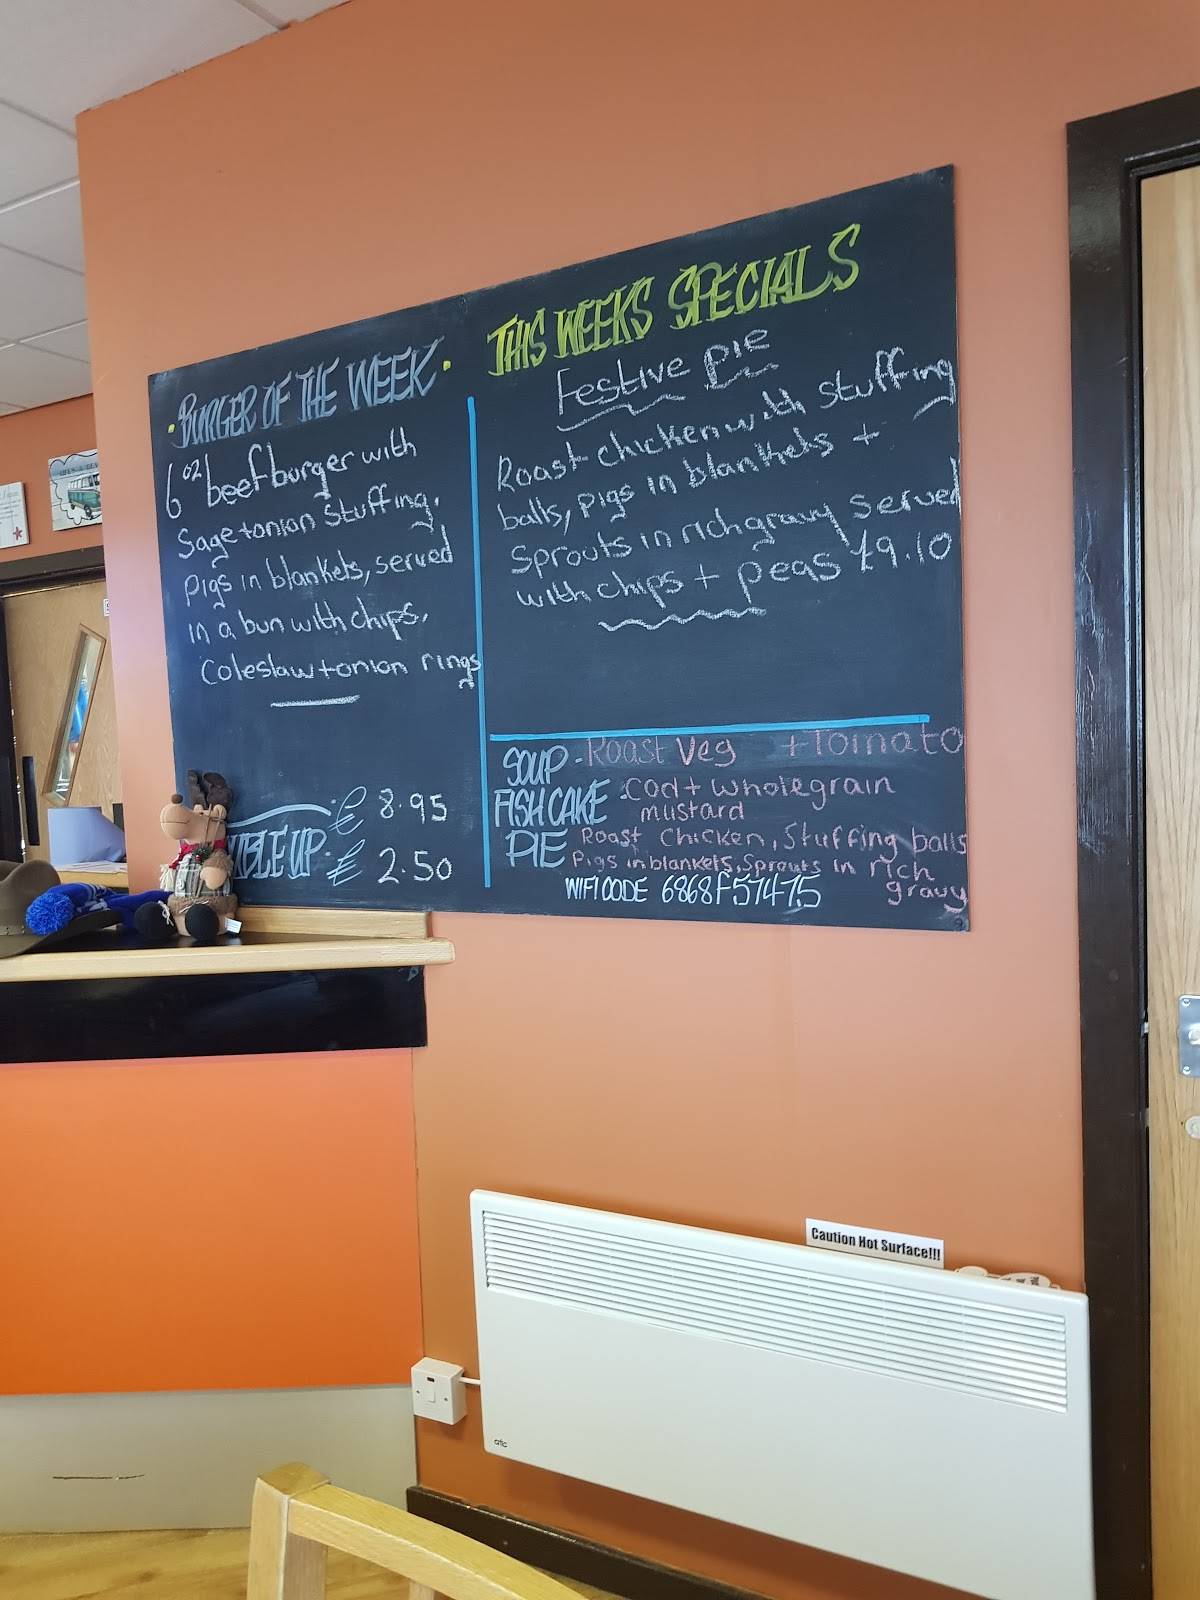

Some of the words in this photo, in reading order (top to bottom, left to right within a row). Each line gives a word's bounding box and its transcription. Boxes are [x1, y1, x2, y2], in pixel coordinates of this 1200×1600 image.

[487, 307, 548, 377] THIS
[553, 275, 655, 359] WEEKS
[668, 223, 861, 330] SPECIALS
[171, 392, 258, 449] BURGER
[260, 371, 293, 430] OF
[295, 356, 340, 422] THE
[346, 335, 445, 412] WEEK
[362, 427, 417, 466] with
[498, 441, 588, 492] Roast
[647, 474, 678, 496] in
[683, 426, 834, 489] blankets
[177, 528, 238, 569] Sage
[242, 575, 262, 593] in
[375, 524, 454, 574] served
[640, 532, 672, 550] in
[516, 581, 592, 608] with
[597, 570, 684, 610] chips
[737, 552, 842, 605] peas
[188, 624, 211, 645] in
[218, 621, 237, 641] a
[238, 610, 285, 636] bun
[291, 600, 347, 635] with
[421, 650, 483, 690] rings
[502, 745, 569, 787] SOUP
[585, 736, 665, 768] Roast
[675, 735, 737, 768] Veg
[378, 788, 448, 825] 8.95
[494, 787, 546, 828] FISH
[548, 778, 611, 827] CAKE
[640, 800, 744, 823] mustard
[227, 824, 289, 880] UBLE
[378, 846, 453, 884] 2.50
[505, 828, 569, 869] PIE
[581, 826, 643, 848] Roast
[912, 826, 968, 855] balls
[572, 849, 618, 874] Pigs
[627, 857, 646, 871] in
[833, 857, 856, 876] in
[870, 860, 935, 881] rich
[564, 875, 600, 901] WIFI
[601, 876, 650, 903] CODE
[886, 881, 968, 914] gravy
[811, 1227, 856, 1247] Caution
[858, 1236, 879, 1251] Hot
[880, 1238, 942, 1261] Surface!!!
